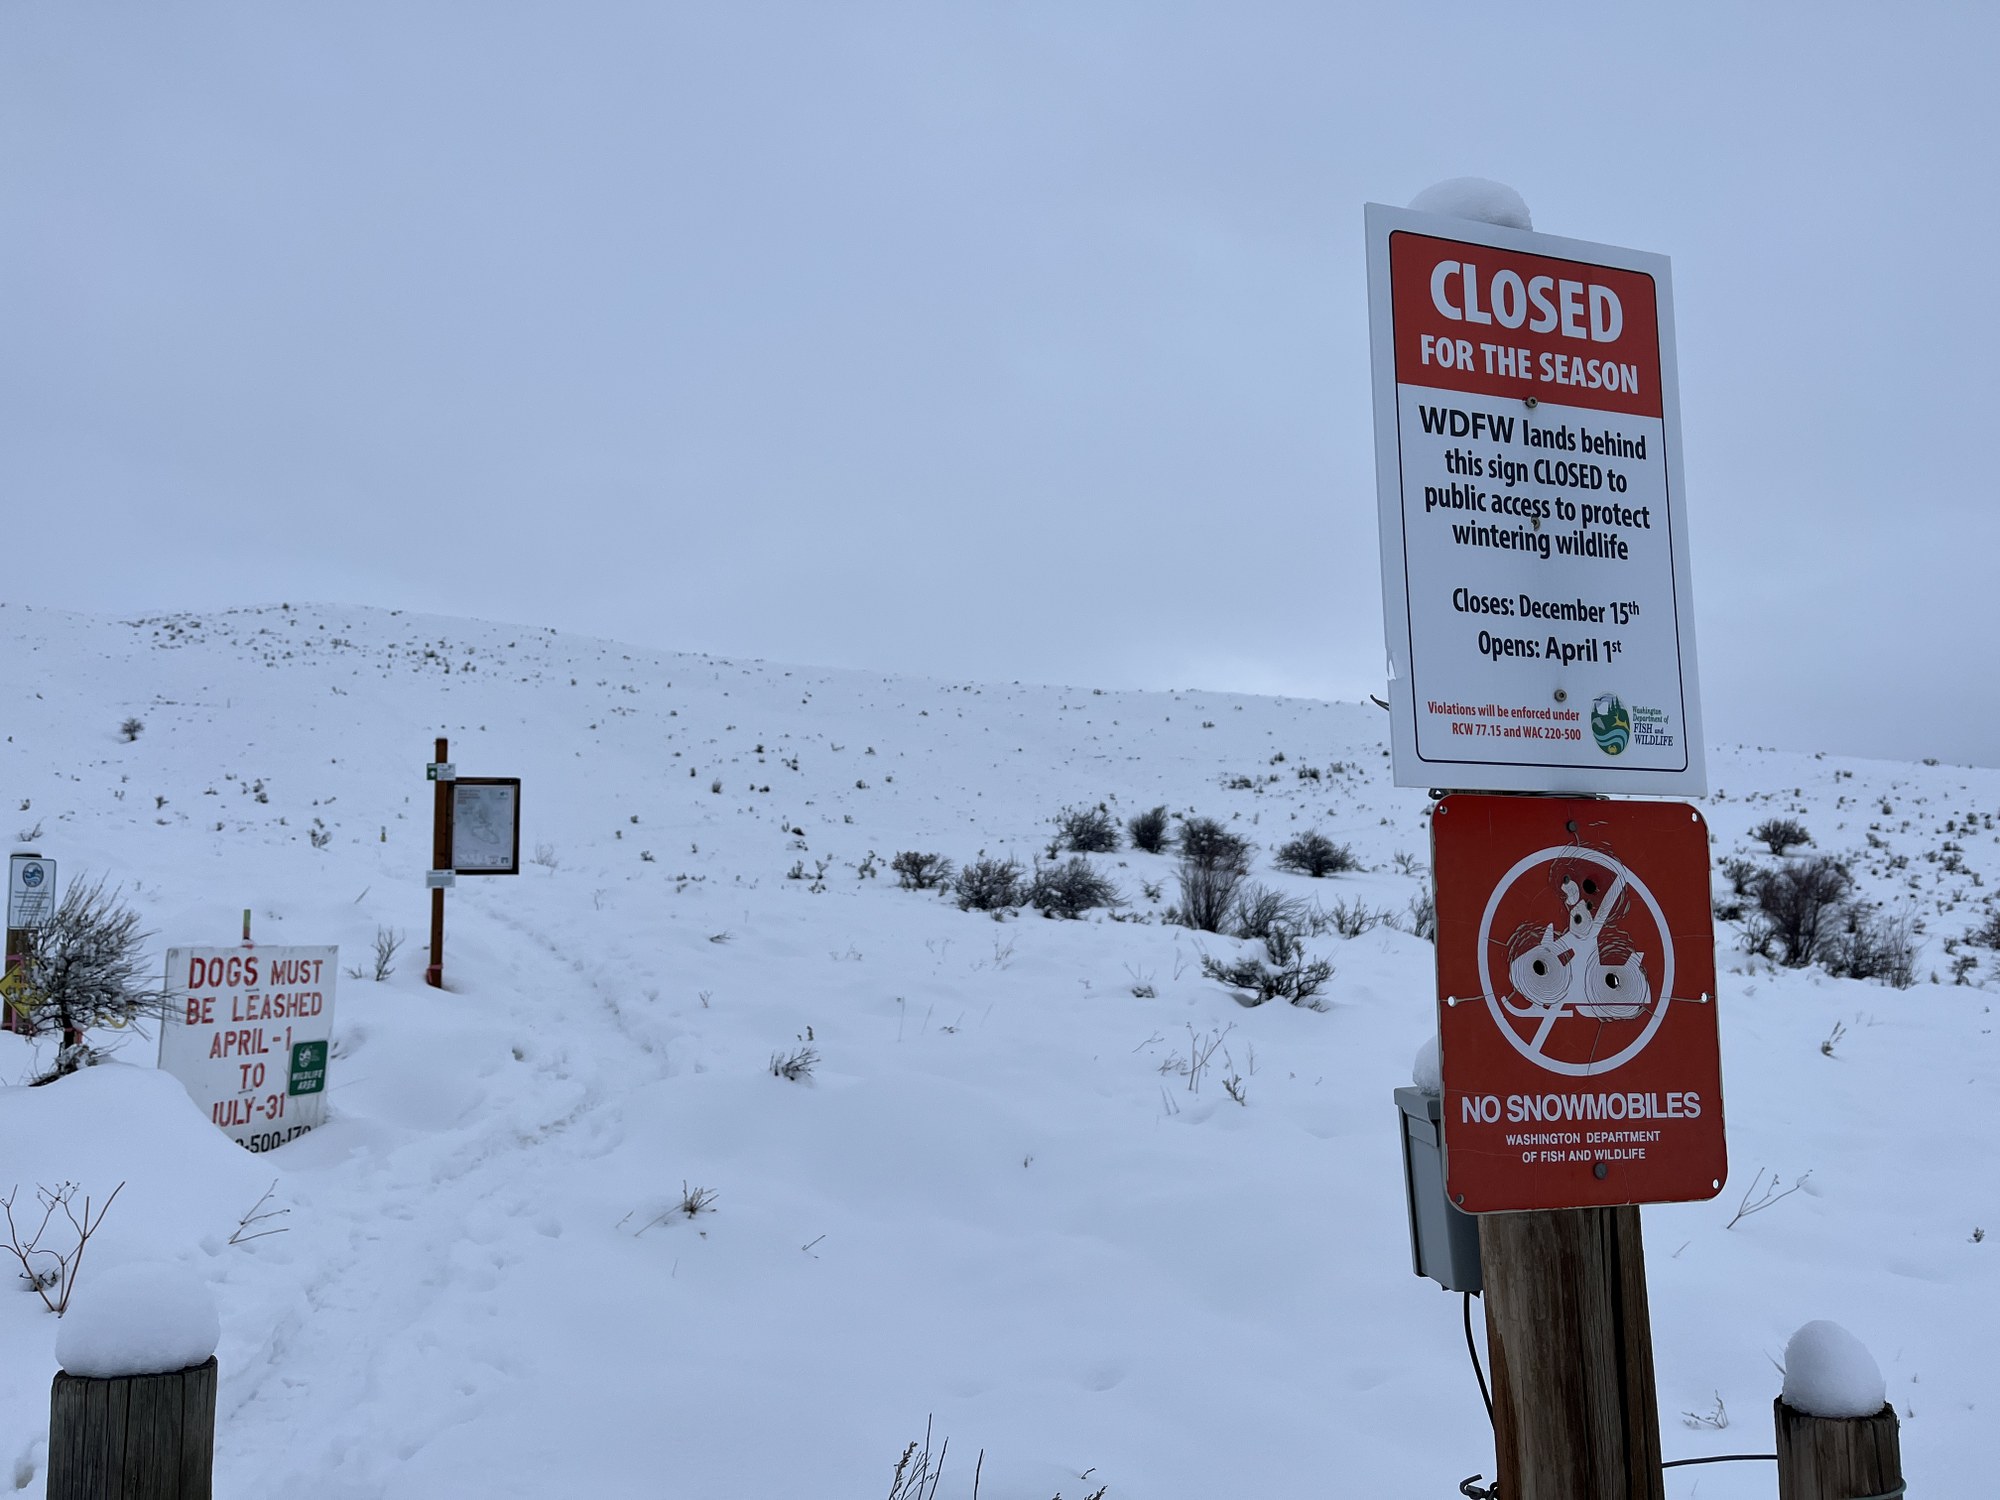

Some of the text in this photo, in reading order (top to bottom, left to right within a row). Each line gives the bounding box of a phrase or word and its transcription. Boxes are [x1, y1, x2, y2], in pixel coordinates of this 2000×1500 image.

[1429, 259, 1624, 344] CLOSED
[1420, 333, 1639, 395] FOR THE SEASON
[1418, 405, 1647, 460] WDFW lands behind
[1445, 448, 1628, 494] this sign CLOSED to
[1424, 482, 1651, 530] public access to protect
[1452, 519, 1629, 561] wintering wildlife
[1452, 587, 1640, 625] Closes: December 15th
[1478, 630, 1623, 667] Opens: April 1st
[1427, 700, 1580, 722] Violations will be enforced under
[1632, 705, 1662, 716] Washington
[1632, 713, 1670, 725] Department of
[1451, 722, 1582, 741] RCW 77.15 and WAC 220-500
[1633, 722, 1664, 735] FISH and
[1634, 734, 1674, 747] WILDLIFE
[188, 956, 324, 990] DOGS MUST
[185, 991, 323, 1026] BE LEASHED
[239, 1062, 266, 1090] TO
[1461, 1091, 1702, 1124] NO SNOWMOBILES
[1505, 1130, 1661, 1146] WASHINGTON DEPARTMENT
[1522, 1147, 1646, 1164] OF FISH AND WILDLIFE
